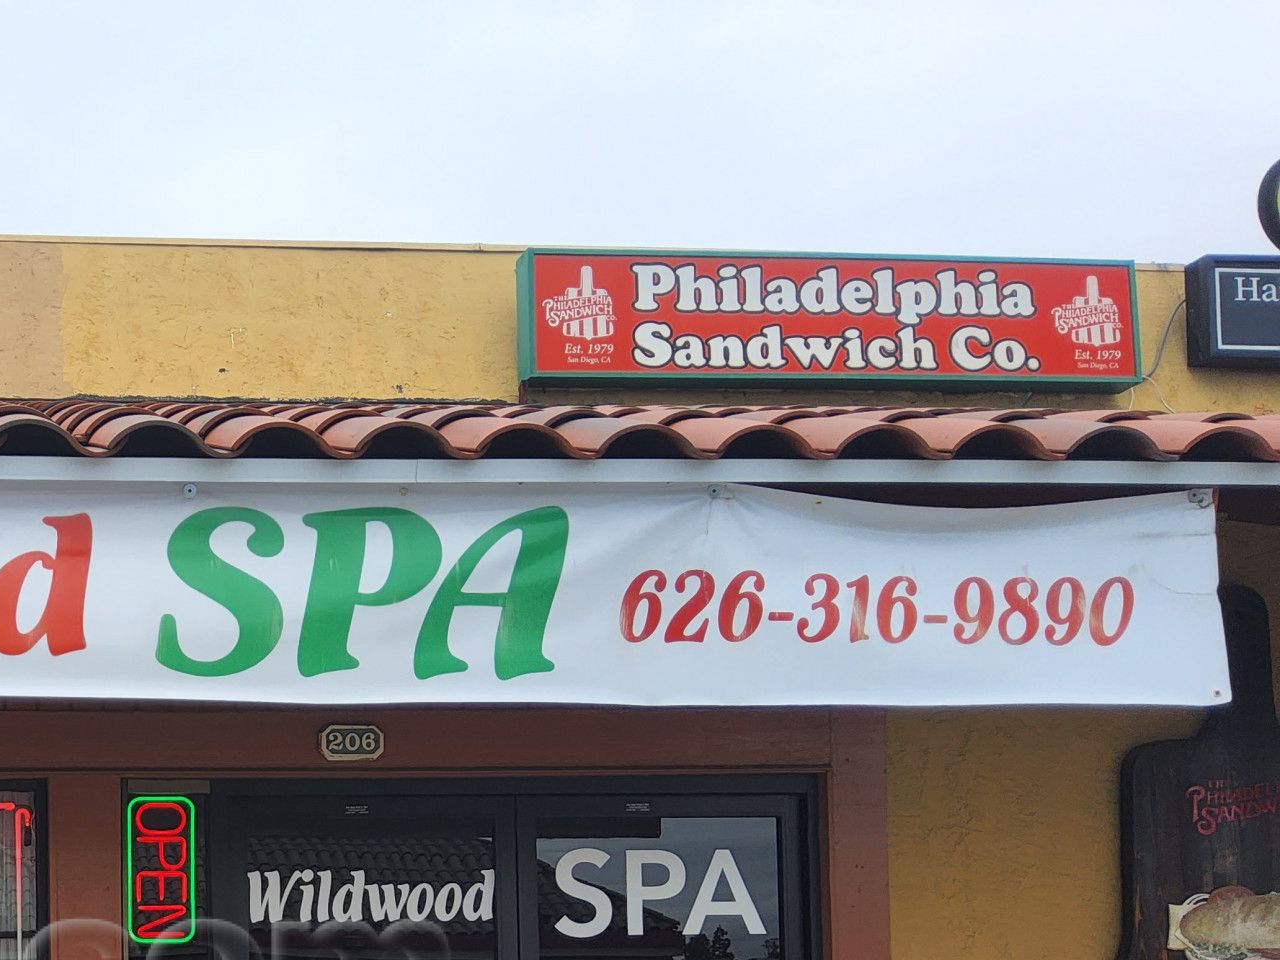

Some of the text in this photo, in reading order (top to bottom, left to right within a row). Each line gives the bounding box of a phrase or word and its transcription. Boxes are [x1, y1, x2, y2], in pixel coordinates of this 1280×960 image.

[631, 262, 1036, 325] Philadelphia
[542, 295, 613, 320] PHILADELPHIA
[548, 304, 613, 327] SANDWICH
[1051, 304, 1118, 327] PHILADELPHIA
[1058, 312, 1119, 334] SANDWICH
[564, 343, 614, 354] Est. 1979
[631, 320, 1041, 372] Sandwich Co.
[1074, 349, 1122, 360] Est. 1979
[154, 505, 571, 681] SPA
[617, 568, 1136, 647] 626-316-9890
[328, 732, 376, 751] 206
[134, 802, 188, 938] OPEN
[248, 848, 768, 939] Wildwood SPA
